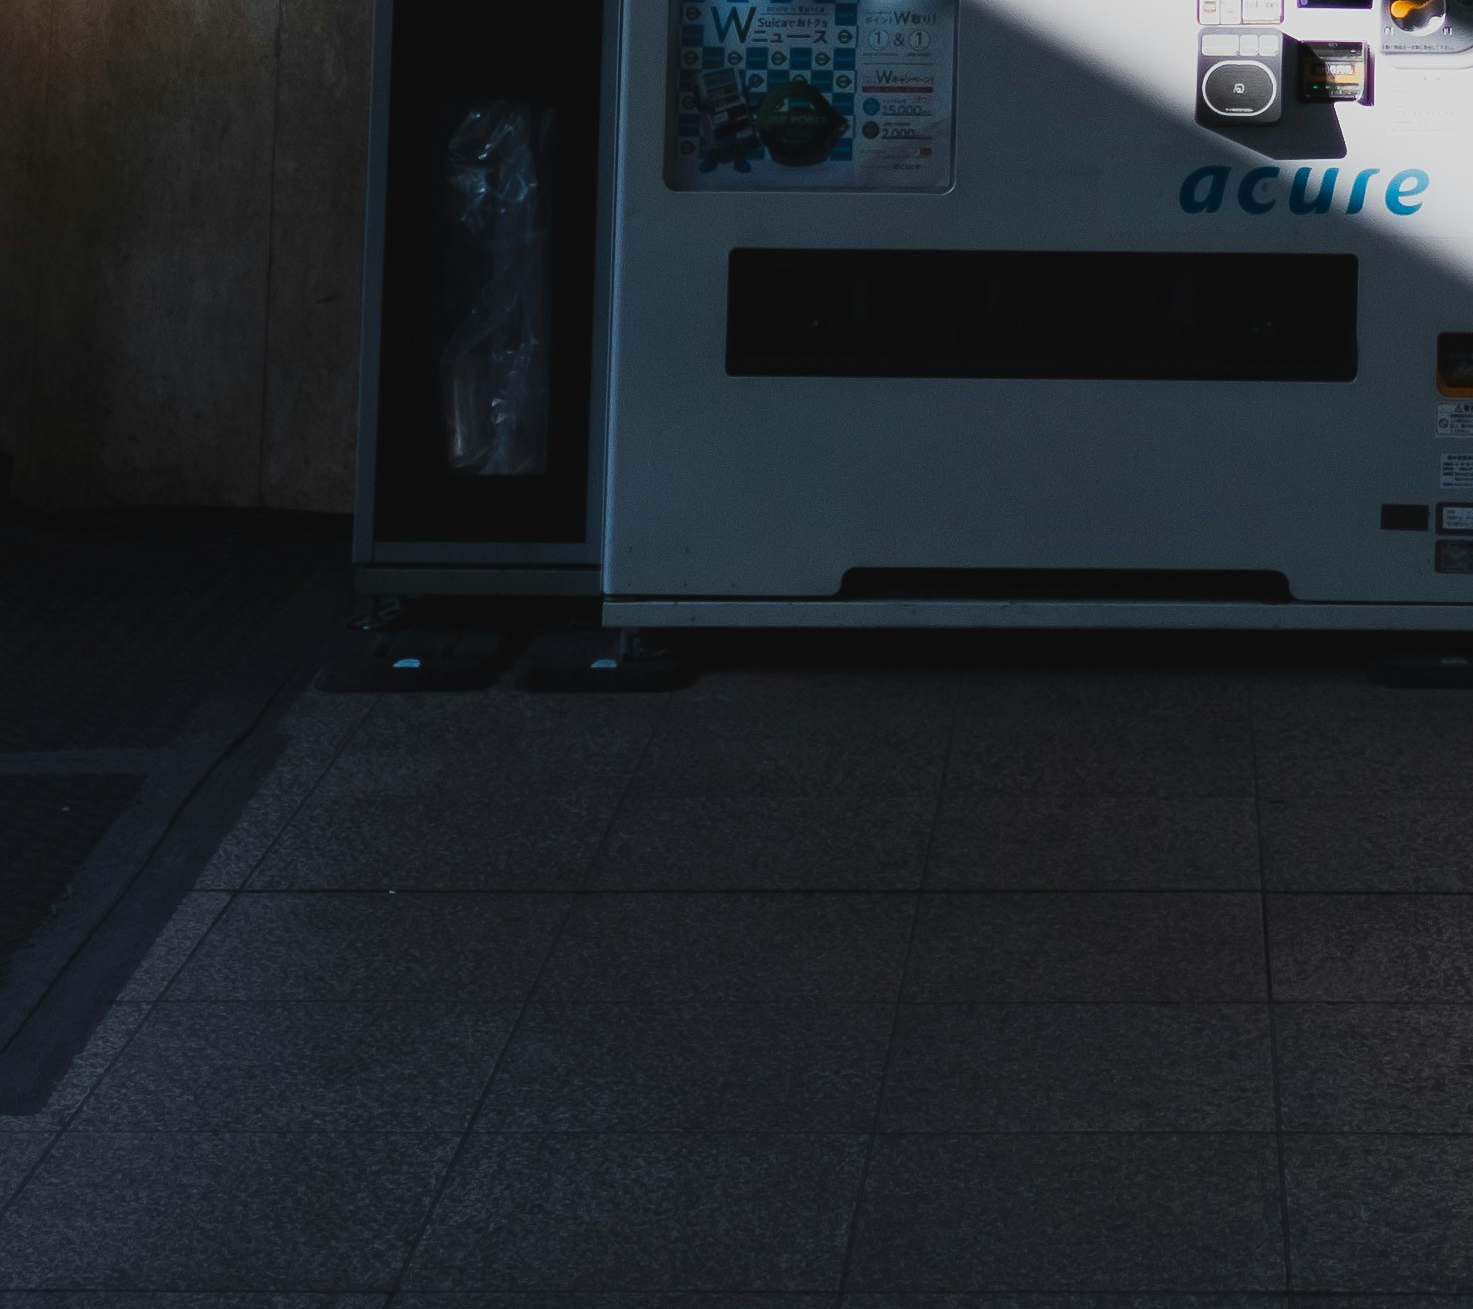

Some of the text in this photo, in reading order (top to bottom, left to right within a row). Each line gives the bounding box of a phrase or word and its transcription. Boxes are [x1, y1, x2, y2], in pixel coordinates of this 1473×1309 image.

[710, 5, 756, 44] W
[752, 30, 828, 44] ニュース
[893, 33, 905, 47] &
[1178, 165, 1430, 216] acure
